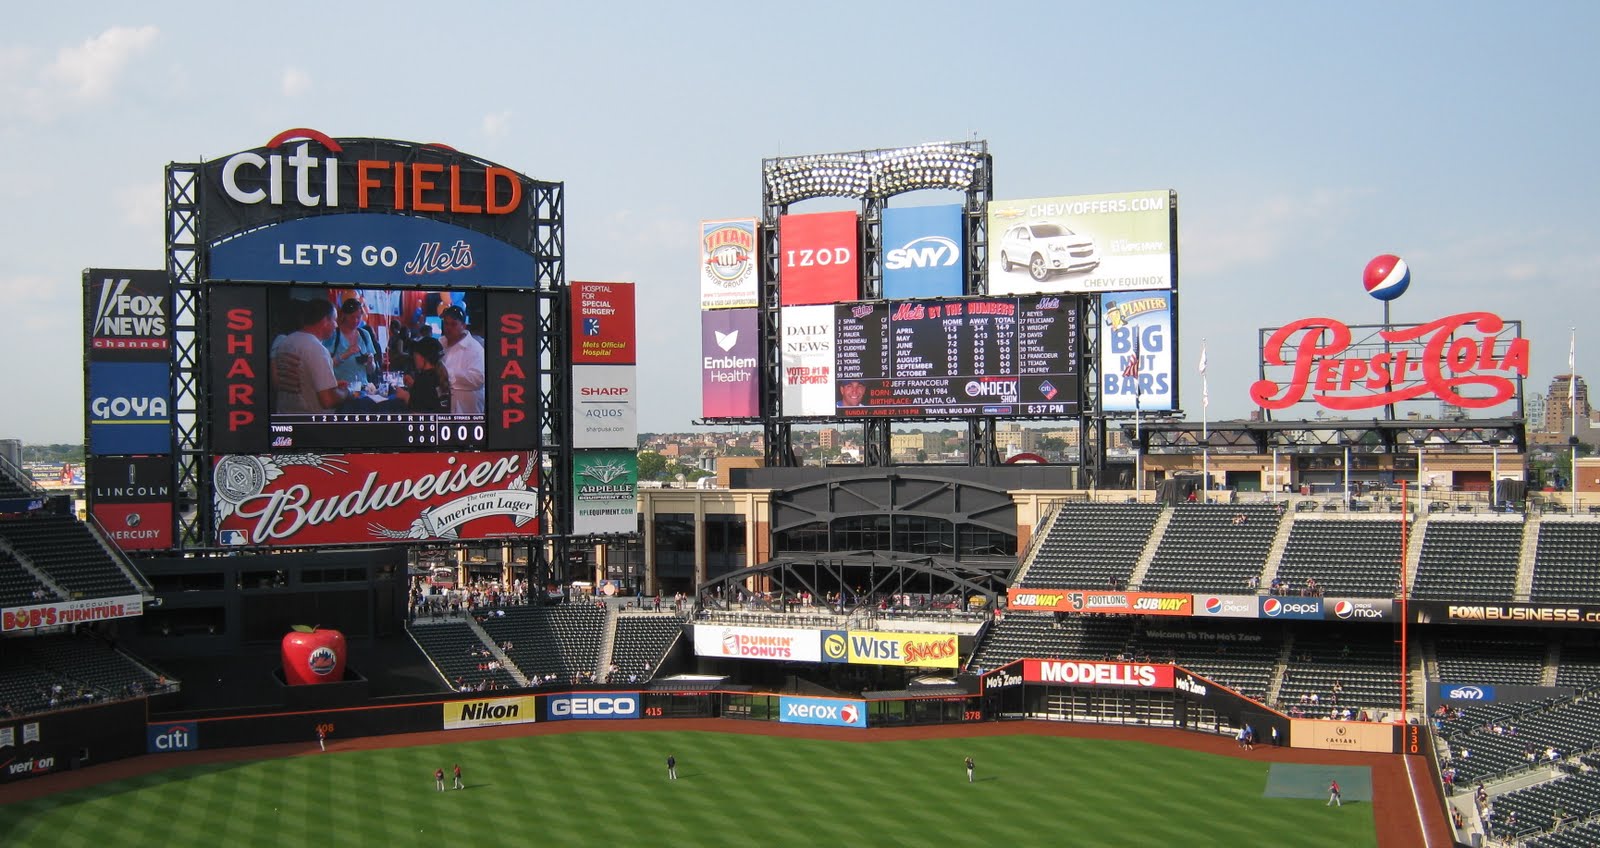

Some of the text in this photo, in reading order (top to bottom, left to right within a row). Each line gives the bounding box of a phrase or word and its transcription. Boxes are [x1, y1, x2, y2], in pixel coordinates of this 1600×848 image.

[222, 142, 522, 214] citi FIELD
[1029, 197, 1164, 217] CHEVYOFFERS.COM
[707, 229, 750, 249] TITAN
[279, 240, 475, 275] LET'S GO Mets
[787, 247, 850, 268] IZOD
[885, 243, 951, 270] SNY
[582, 285, 612, 293] HOSPITAL
[1084, 276, 1164, 288] CHEVY EQUINOX
[117, 295, 165, 315] FOX
[582, 300, 611, 308] SPECIAL
[892, 302, 1015, 321] Mets BY THE NUMBERS
[1120, 299, 1166, 316] PLANTERS
[104, 316, 166, 336] NEWS
[787, 325, 829, 336] DAILY
[94, 340, 167, 348] channel
[787, 341, 830, 352] NEWS
[1110, 324, 1163, 354] BIG
[582, 349, 612, 357] Hospital
[226, 308, 255, 432] SHARP
[704, 356, 756, 369] Emblem
[500, 313, 526, 429] SHARP
[711, 370, 750, 383] Health
[787, 367, 810, 376] VOTED
[800, 375, 828, 384] SPORTS
[1104, 373, 1169, 395] BARS
[581, 387, 628, 396] SHARP
[91, 396, 167, 419] GOYA
[586, 409, 623, 418] AQUOS
[1028, 405, 1063, 413] 5:37 PM
[441, 425, 451, 441] 0
[458, 425, 467, 441] 0
[474, 425, 484, 441] 0
[97, 487, 168, 496] LINCOLN
[580, 485, 633, 493] ARPIELLE
[234, 454, 520, 544] Budweiser
[436, 498, 533, 529] American Lager
[106, 530, 160, 539] MERCURY
[70, 601, 114, 609] DISCOUNT
[1013, 593, 1188, 611] SUBWAY $5 FOOTLONG SUBWAY
[1282, 602, 1319, 615] pepsi
[3, 608, 57, 630] BOB'S
[59, 604, 124, 623] FURNITURE
[1354, 608, 1383, 618] max
[741, 635, 793, 646] DUNKIN'
[1146, 630, 1185, 639] Welcome
[1198, 632, 1215, 640] The
[1217, 632, 1236, 640] Mo's
[1238, 633, 1261, 641] Zone
[741, 646, 791, 658] DONUTS
[851, 635, 956, 664] WISE SNACKS
[987, 674, 1022, 689] Mo's Zone
[1041, 661, 1156, 687] MODELL'S
[1175, 677, 1206, 696] Mo's Zone
[1450, 688, 1479, 699] SNY
[461, 702, 519, 721] Nikon
[552, 697, 635, 716] GEICO
[645, 707, 662, 716] 415
[788, 703, 837, 720] xerox
[964, 711, 981, 720] 378
[316, 723, 334, 732] 408
[156, 730, 188, 749] citi
[10, 757, 54, 774] verizon
